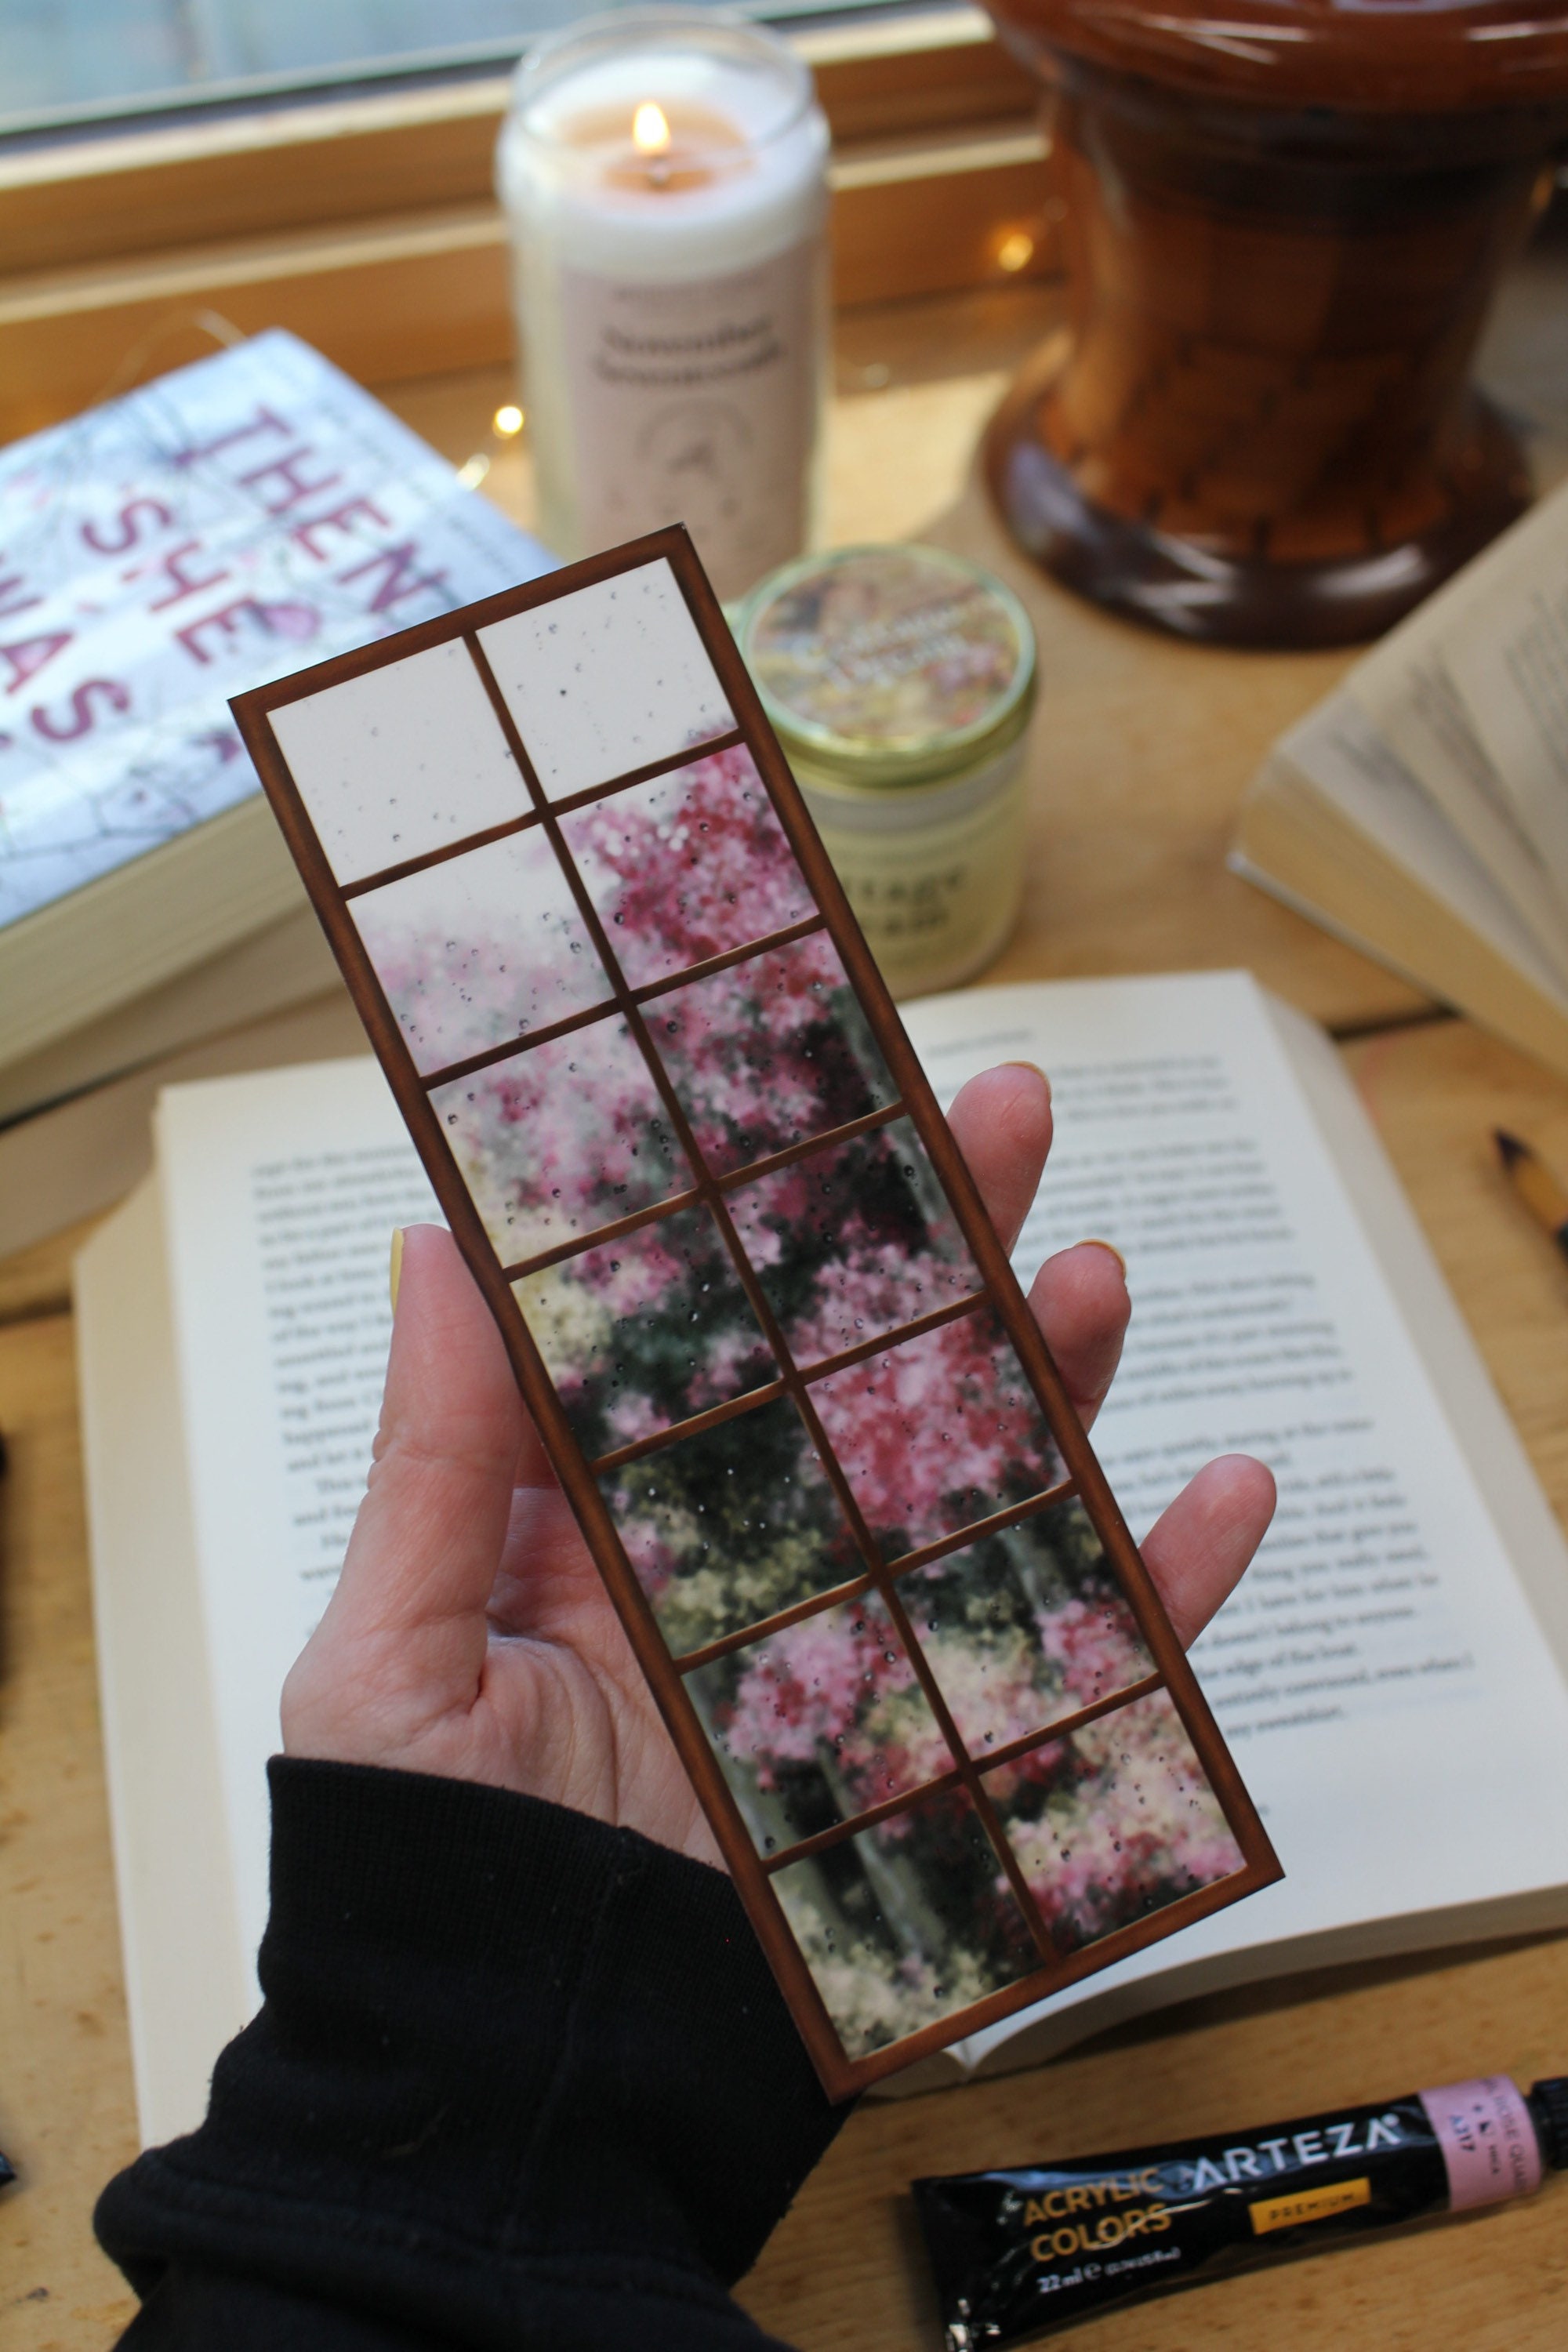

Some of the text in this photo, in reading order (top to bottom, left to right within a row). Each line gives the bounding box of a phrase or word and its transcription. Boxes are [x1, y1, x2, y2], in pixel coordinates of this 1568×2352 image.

[174, 401, 450, 615] THEN
[82, 495, 255, 666] SHE
[1192, 2115, 1402, 2193] ARTEZA
[1024, 2167, 1165, 2227] ACRYLIC
[1269, 2192, 1356, 2221] PREMIUM
[1030, 2202, 1172, 2263] COLORS
